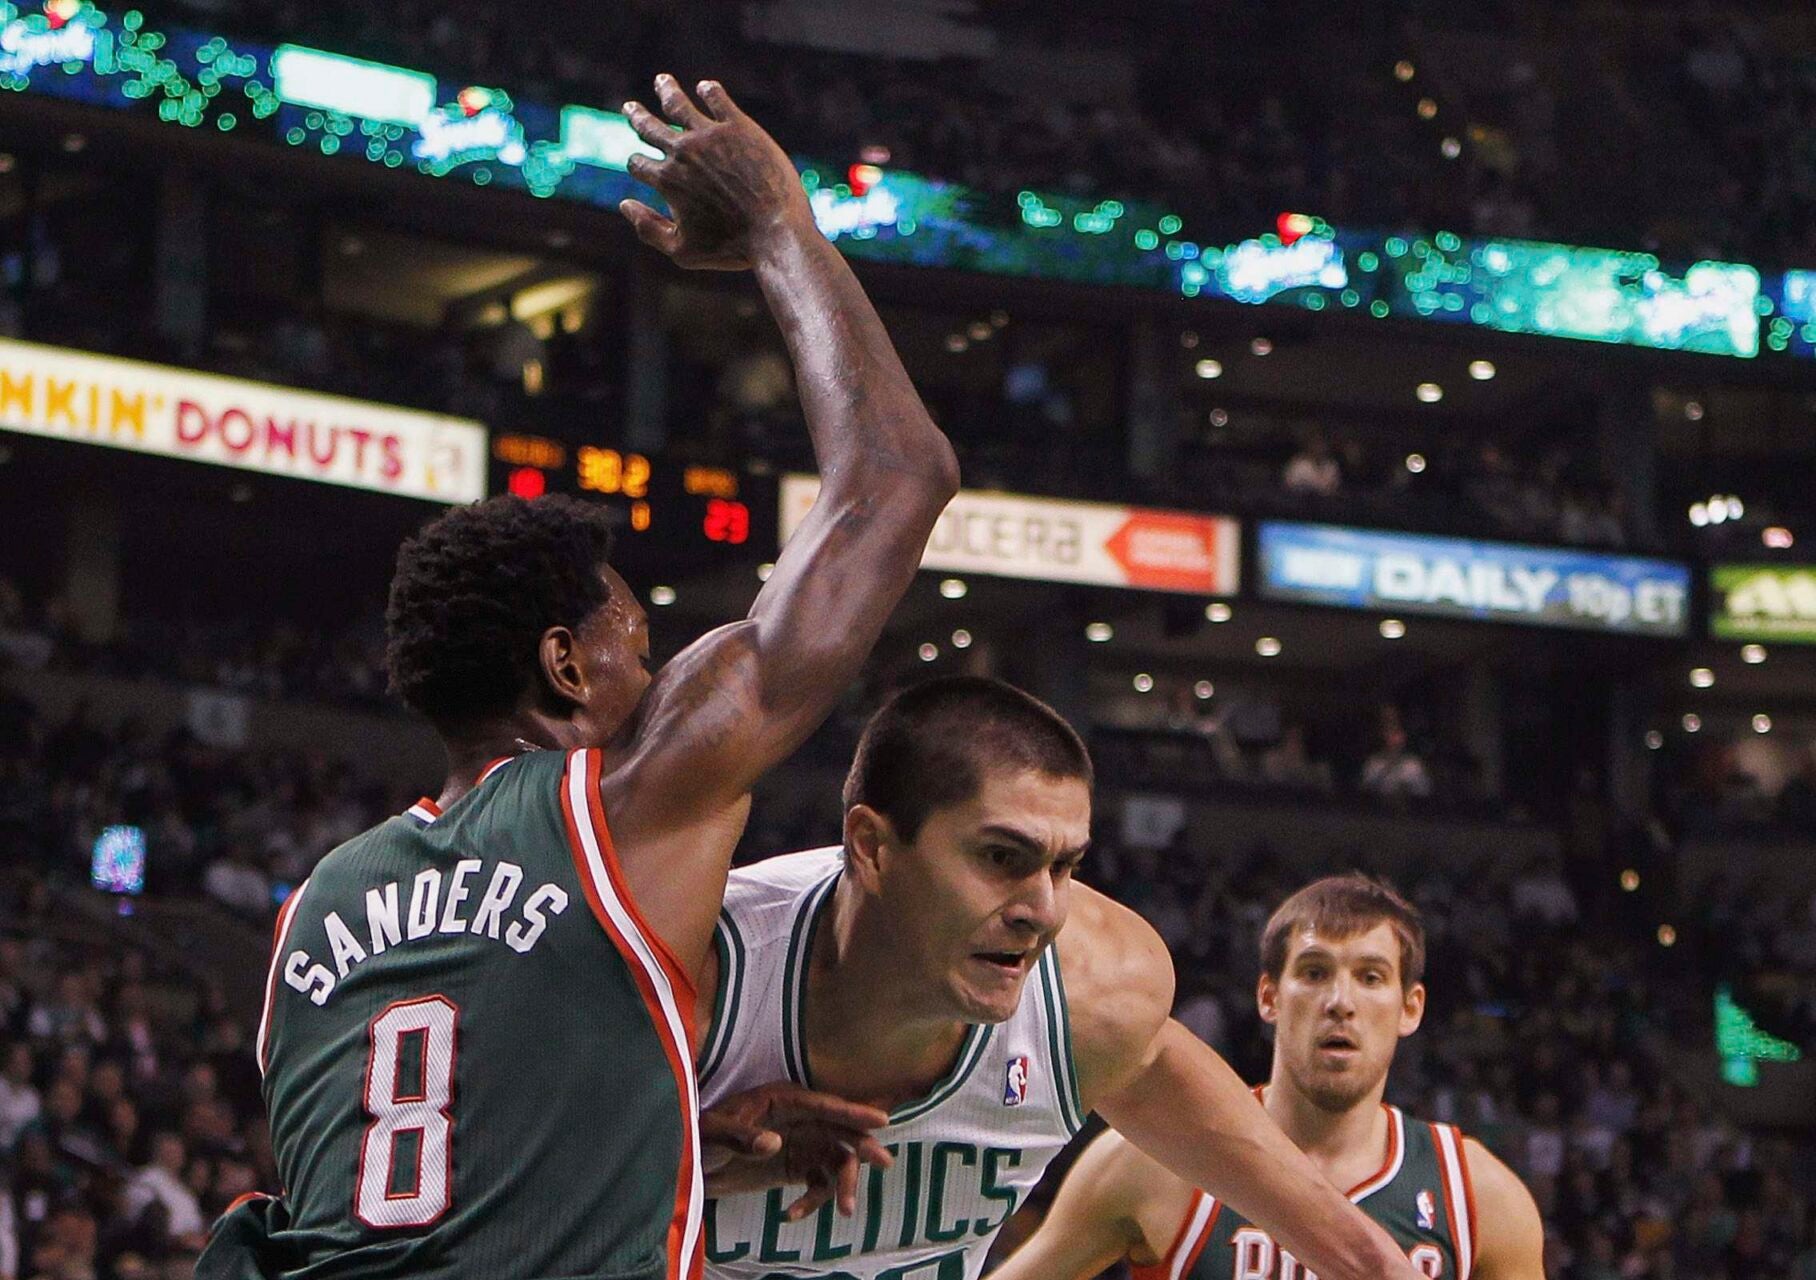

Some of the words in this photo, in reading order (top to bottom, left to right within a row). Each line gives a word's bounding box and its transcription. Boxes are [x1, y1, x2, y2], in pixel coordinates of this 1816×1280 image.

[177, 400, 404, 480] DONUTS
[928, 510, 1082, 564] OCERA
[1376, 552, 1559, 613] DAILY
[284, 859, 569, 1006] SANDERS
[354, 994, 459, 1229] 8
